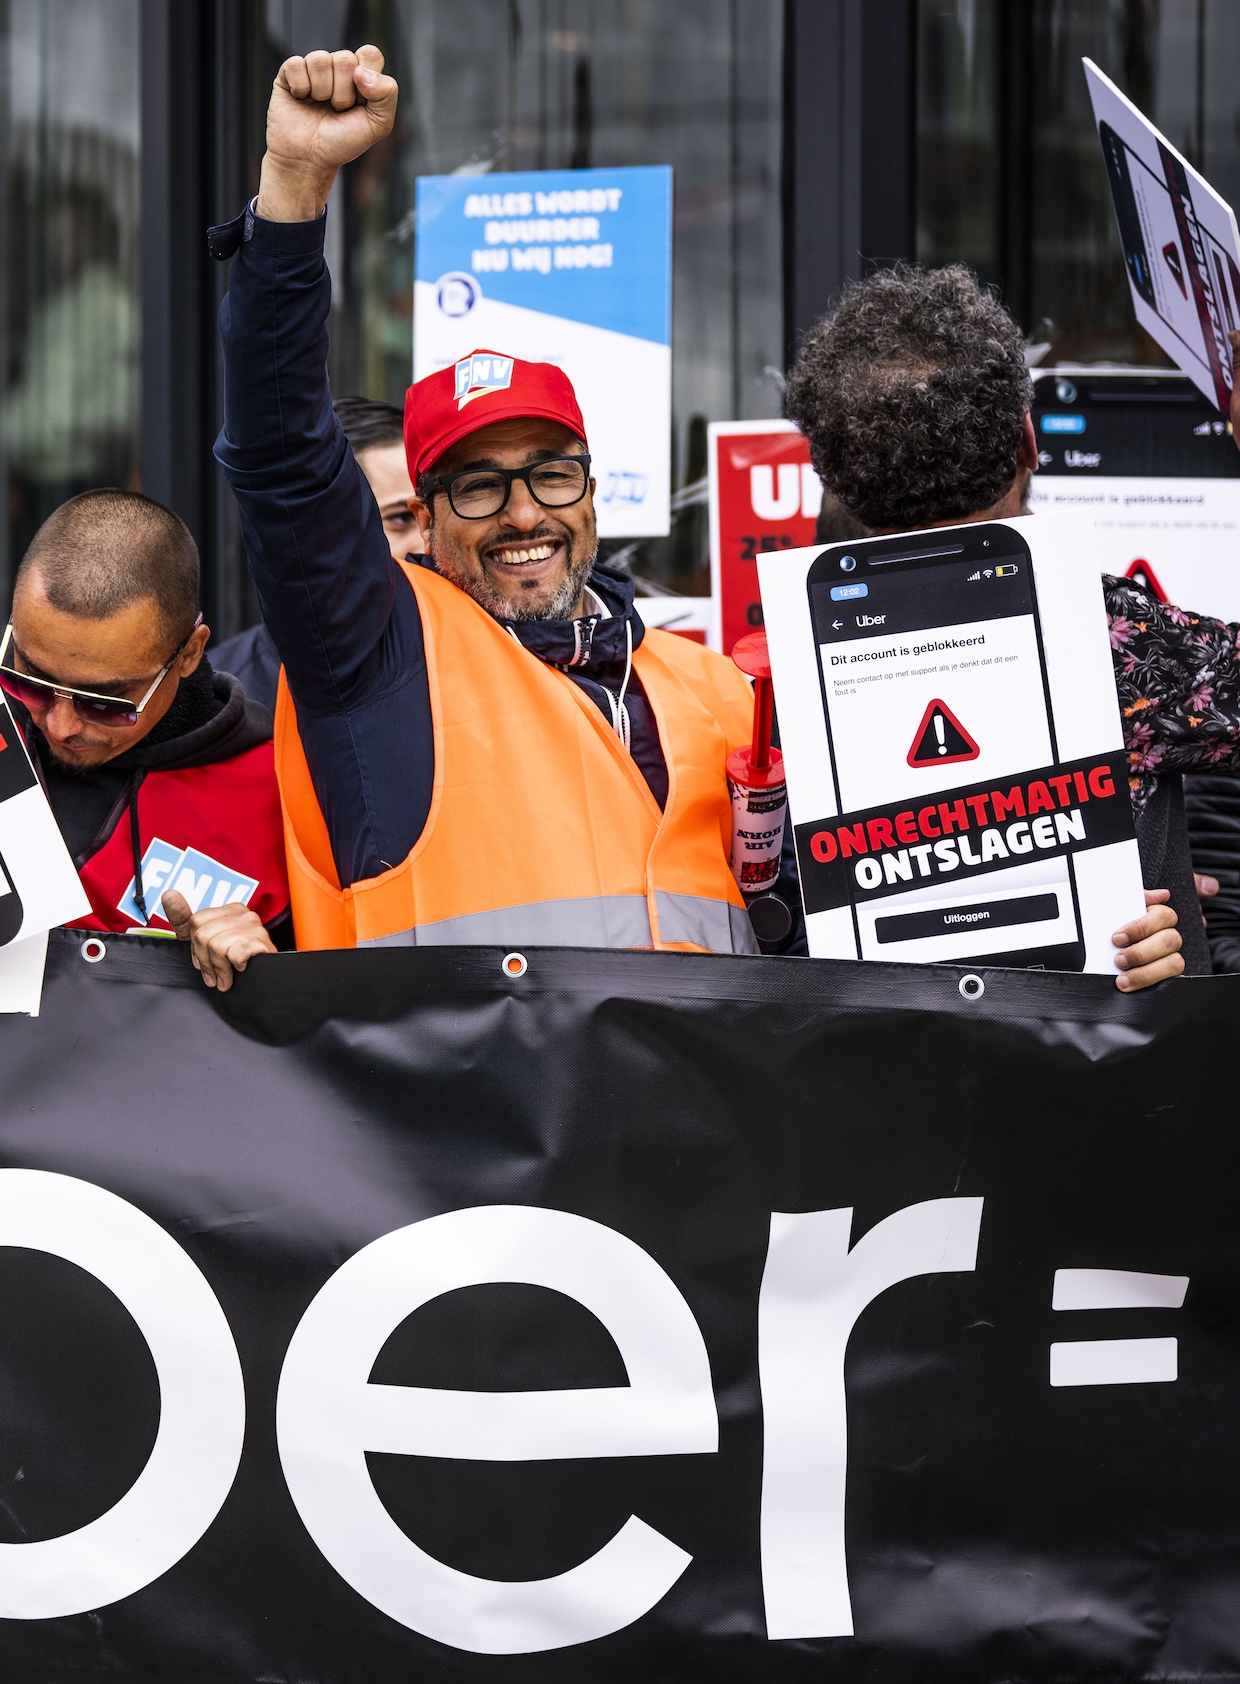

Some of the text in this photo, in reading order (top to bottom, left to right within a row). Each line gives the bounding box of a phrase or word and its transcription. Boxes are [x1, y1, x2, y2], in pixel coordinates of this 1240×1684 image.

[463, 188, 623, 218] ALLES WORDT
[484, 216, 600, 245] DUURDER
[457, 359, 511, 394] FNV
[839, 587, 860, 597] 12:02
[855, 614, 886, 628] Uber
[830, 634, 986, 666] Dit account is geblokkeerd
[833, 678, 856, 687] Neem
[856, 674, 883, 684] contact
[884, 673, 894, 681] op
[910, 666, 938, 676] support
[939, 664, 950, 672] als
[951, 663, 958, 671] je
[959, 660, 980, 669] denkt
[980, 658, 993, 666] dat
[993, 656, 1003, 664] dit
[1004, 654, 1019, 662] een
[834, 688, 849, 696] fout
[809, 765, 1116, 864] ONRECHTMATIG
[736, 825, 782, 840] HORN
[744, 839, 775, 850] AIR
[854, 808, 1087, 890] ONTSLAGEN
[943, 909, 990, 925] Uitloggen
